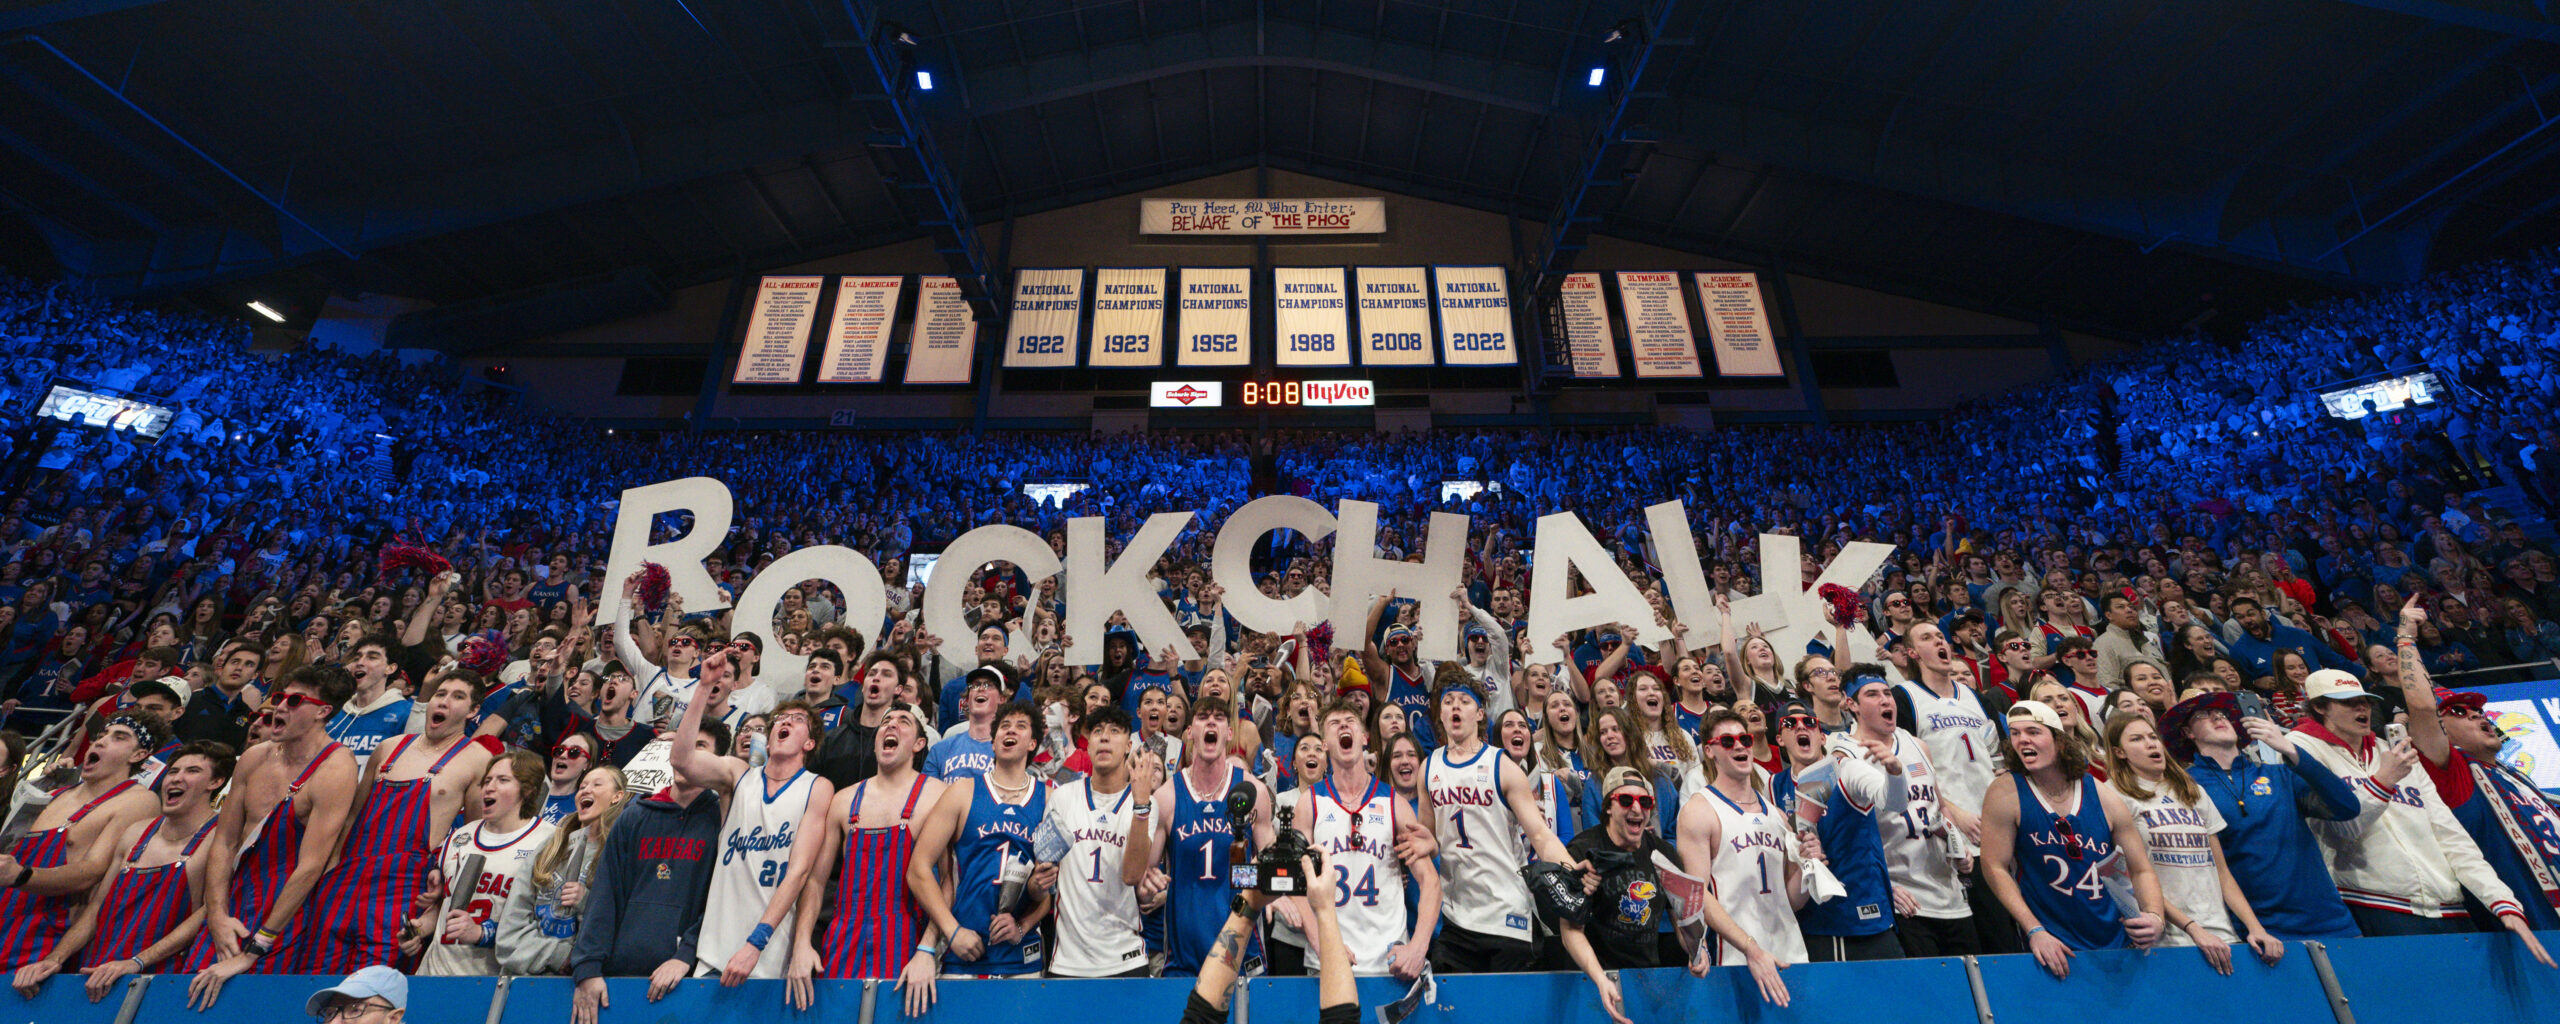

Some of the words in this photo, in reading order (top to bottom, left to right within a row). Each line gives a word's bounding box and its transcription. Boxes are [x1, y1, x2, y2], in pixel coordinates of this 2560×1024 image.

[1170, 201, 1197, 216] Pay
[1244, 201, 1263, 213] All
[1267, 201, 1298, 213] Who
[1171, 214, 1232, 231] BEWARE
[1241, 216, 1263, 229] OF
[764, 281, 820, 289] ALL-AMERICANS
[843, 280, 900, 289] ALL-AMERICANS
[1626, 274, 1671, 282] OLYMPIANS
[1021, 284, 1074, 295] NATIONAL
[1104, 284, 1158, 295] NATIONAL
[1189, 283, 1243, 294] NATIONAL
[1284, 283, 1338, 294] NATIONAL
[1366, 283, 1420, 294] NATIONAL
[1446, 282, 1501, 293] NATIONAL
[1012, 299, 1078, 311] CHAMPIONS
[1096, 299, 1162, 310] CHAMPIONS
[1182, 298, 1248, 309] CHAMPIONS
[1278, 298, 1344, 309] CHAMPIONS
[1361, 298, 1427, 309] CHAMPIONS
[1441, 297, 1508, 308] CHAMPIONS
[1017, 335, 1065, 354] 1922
[1103, 334, 1150, 353] 1923
[1192, 334, 1238, 352] 1952
[1290, 333, 1335, 352] 1988
[1371, 333, 1422, 351] 2008
[1453, 332, 1506, 351] 2022
[1243, 381, 1299, 405] 8:08
[833, 410, 854, 425] 21
[38, 669, 58, 677] KAN
[1393, 694, 1431, 708] KANSA
[1927, 712, 1984, 731] Kansas
[337, 734, 383, 751] NSAS
[1960, 732, 1976, 762] 1
[944, 753, 996, 775] KANSA
[1429, 785, 1494, 809] KANSAS
[1908, 784, 1935, 801] SAS
[2141, 807, 2206, 829] KANSA
[2474, 768, 2550, 885] JAYHAWKS
[1074, 828, 1126, 848] KANSAS
[1176, 817, 1233, 842] KANSA
[1450, 808, 1473, 850] 1
[637, 836, 706, 862] KANSAS
[723, 821, 794, 866] Jayhawks
[1730, 831, 1784, 854] KANSA
[2028, 830, 2109, 856] KANSAS
[992, 839, 1011, 885] 1
[1087, 846, 1104, 883] 1
[1199, 838, 1217, 881] 1
[2152, 852, 2206, 865] BASKETBALL
[1755, 851, 1772, 895] 1
[2043, 854, 2104, 900] 24
[443, 872, 515, 899] KSAS
[1333, 863, 1380, 908] 34
[1629, 904, 1640, 913] KU
